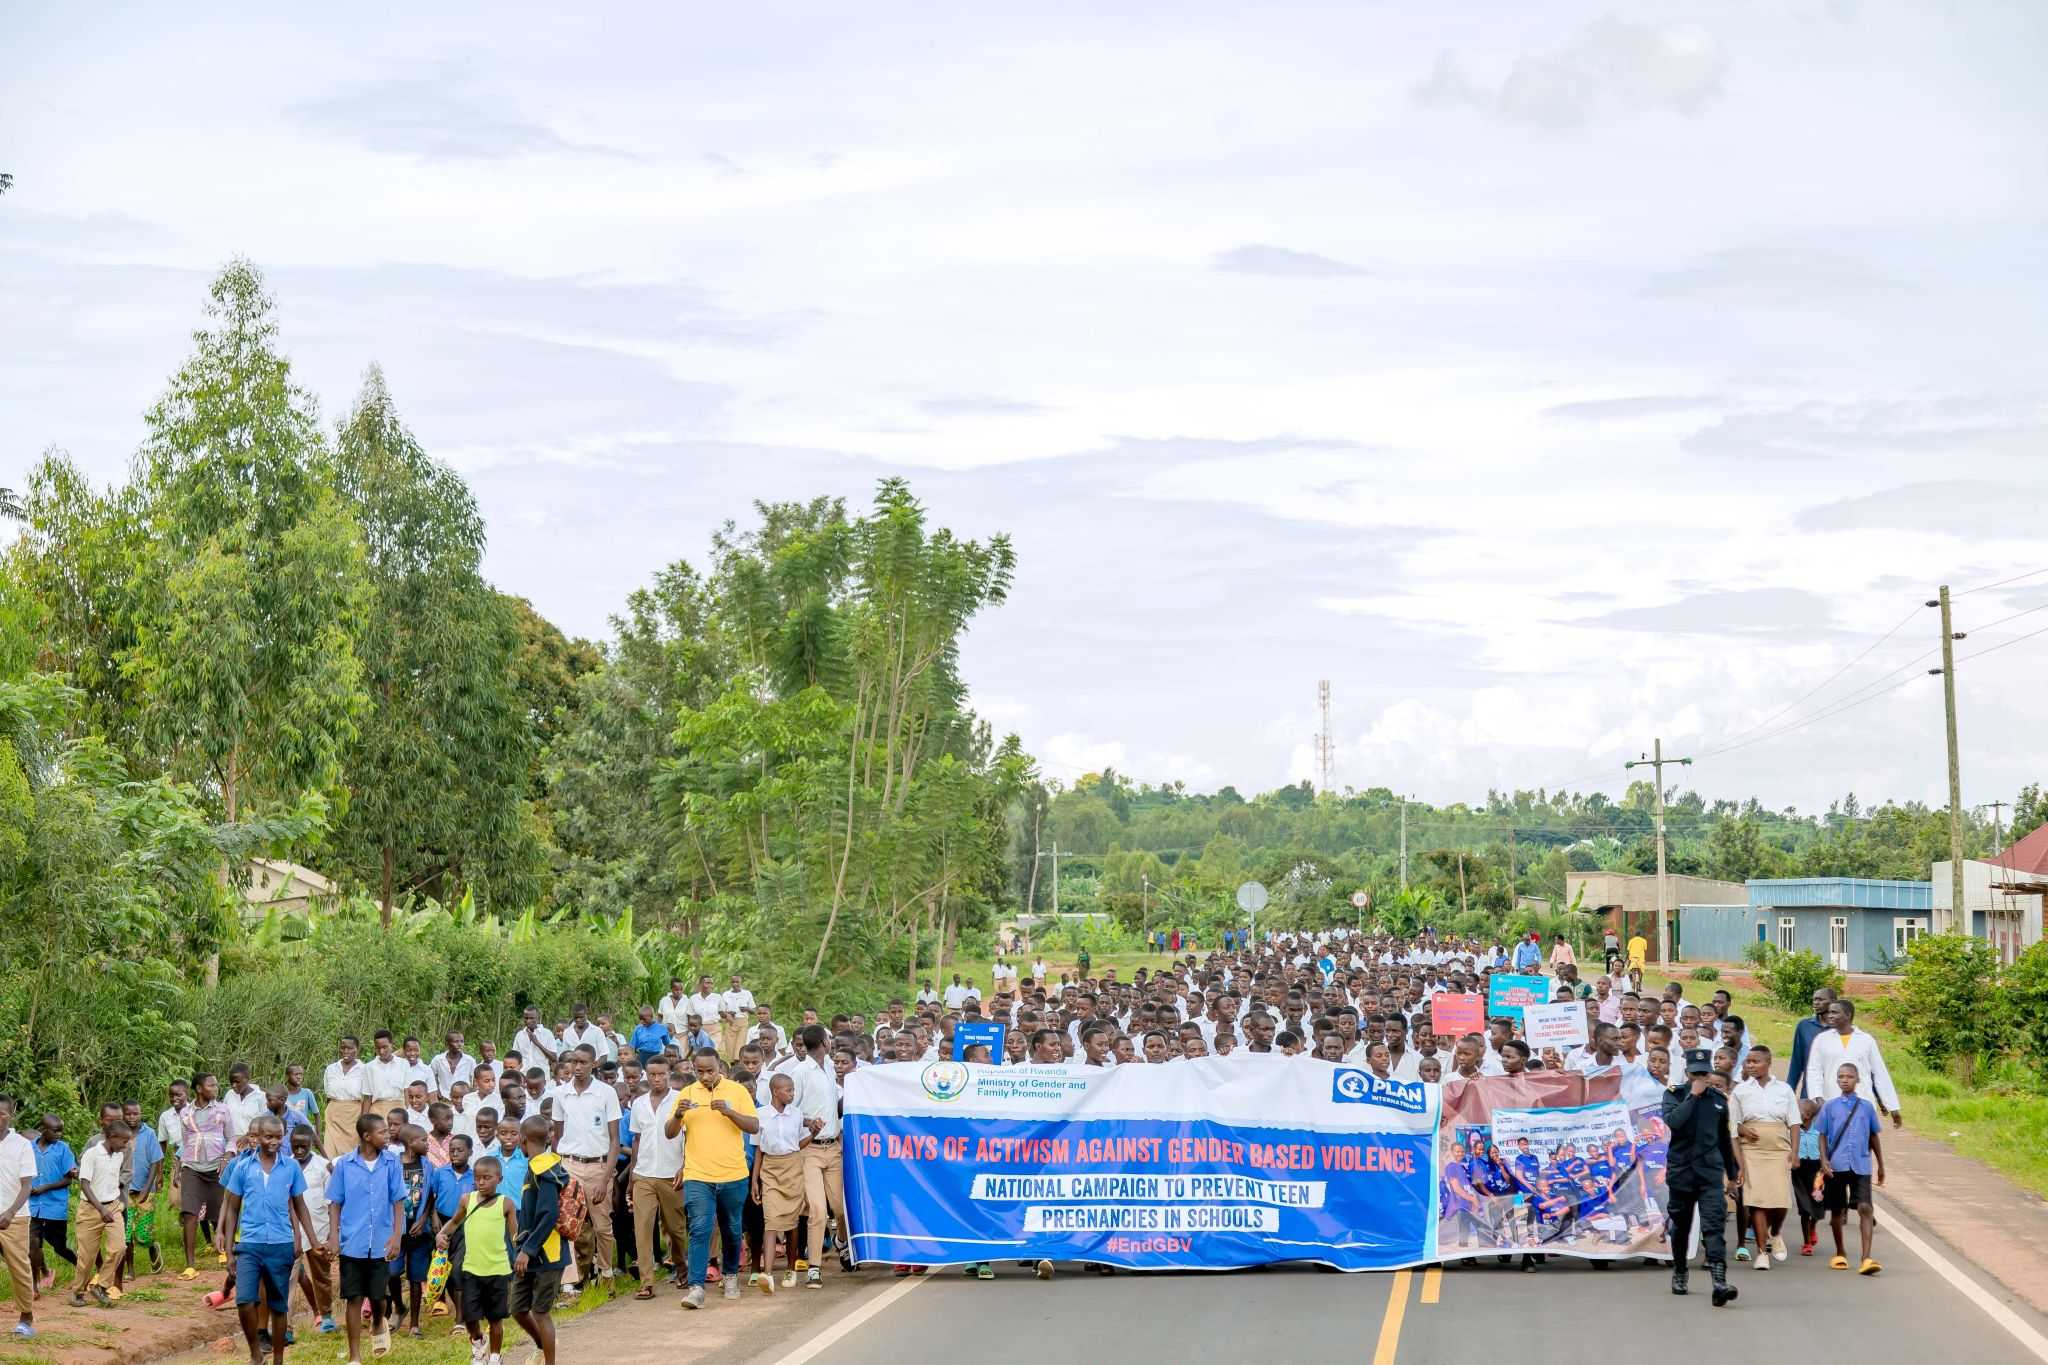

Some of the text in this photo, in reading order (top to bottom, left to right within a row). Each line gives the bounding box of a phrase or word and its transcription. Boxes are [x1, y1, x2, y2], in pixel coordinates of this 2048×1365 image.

[977, 1078, 1086, 1090] Ministry of Gender and
[977, 1088, 1062, 1099] Family Promotion
[1372, 1079, 1422, 1103] PLAN
[861, 1132, 1416, 1174] 16 DAYS OF ACTIVISM AGAINST GENDER BASED VIOLENCE
[985, 1177, 1310, 1205] NATIONAL CAMPAIGN TO PREVENT TEEN
[1042, 1208, 1264, 1229] PREGNANCIES IN SCHOOLS
[1107, 1236, 1192, 1252] #EndGBV
